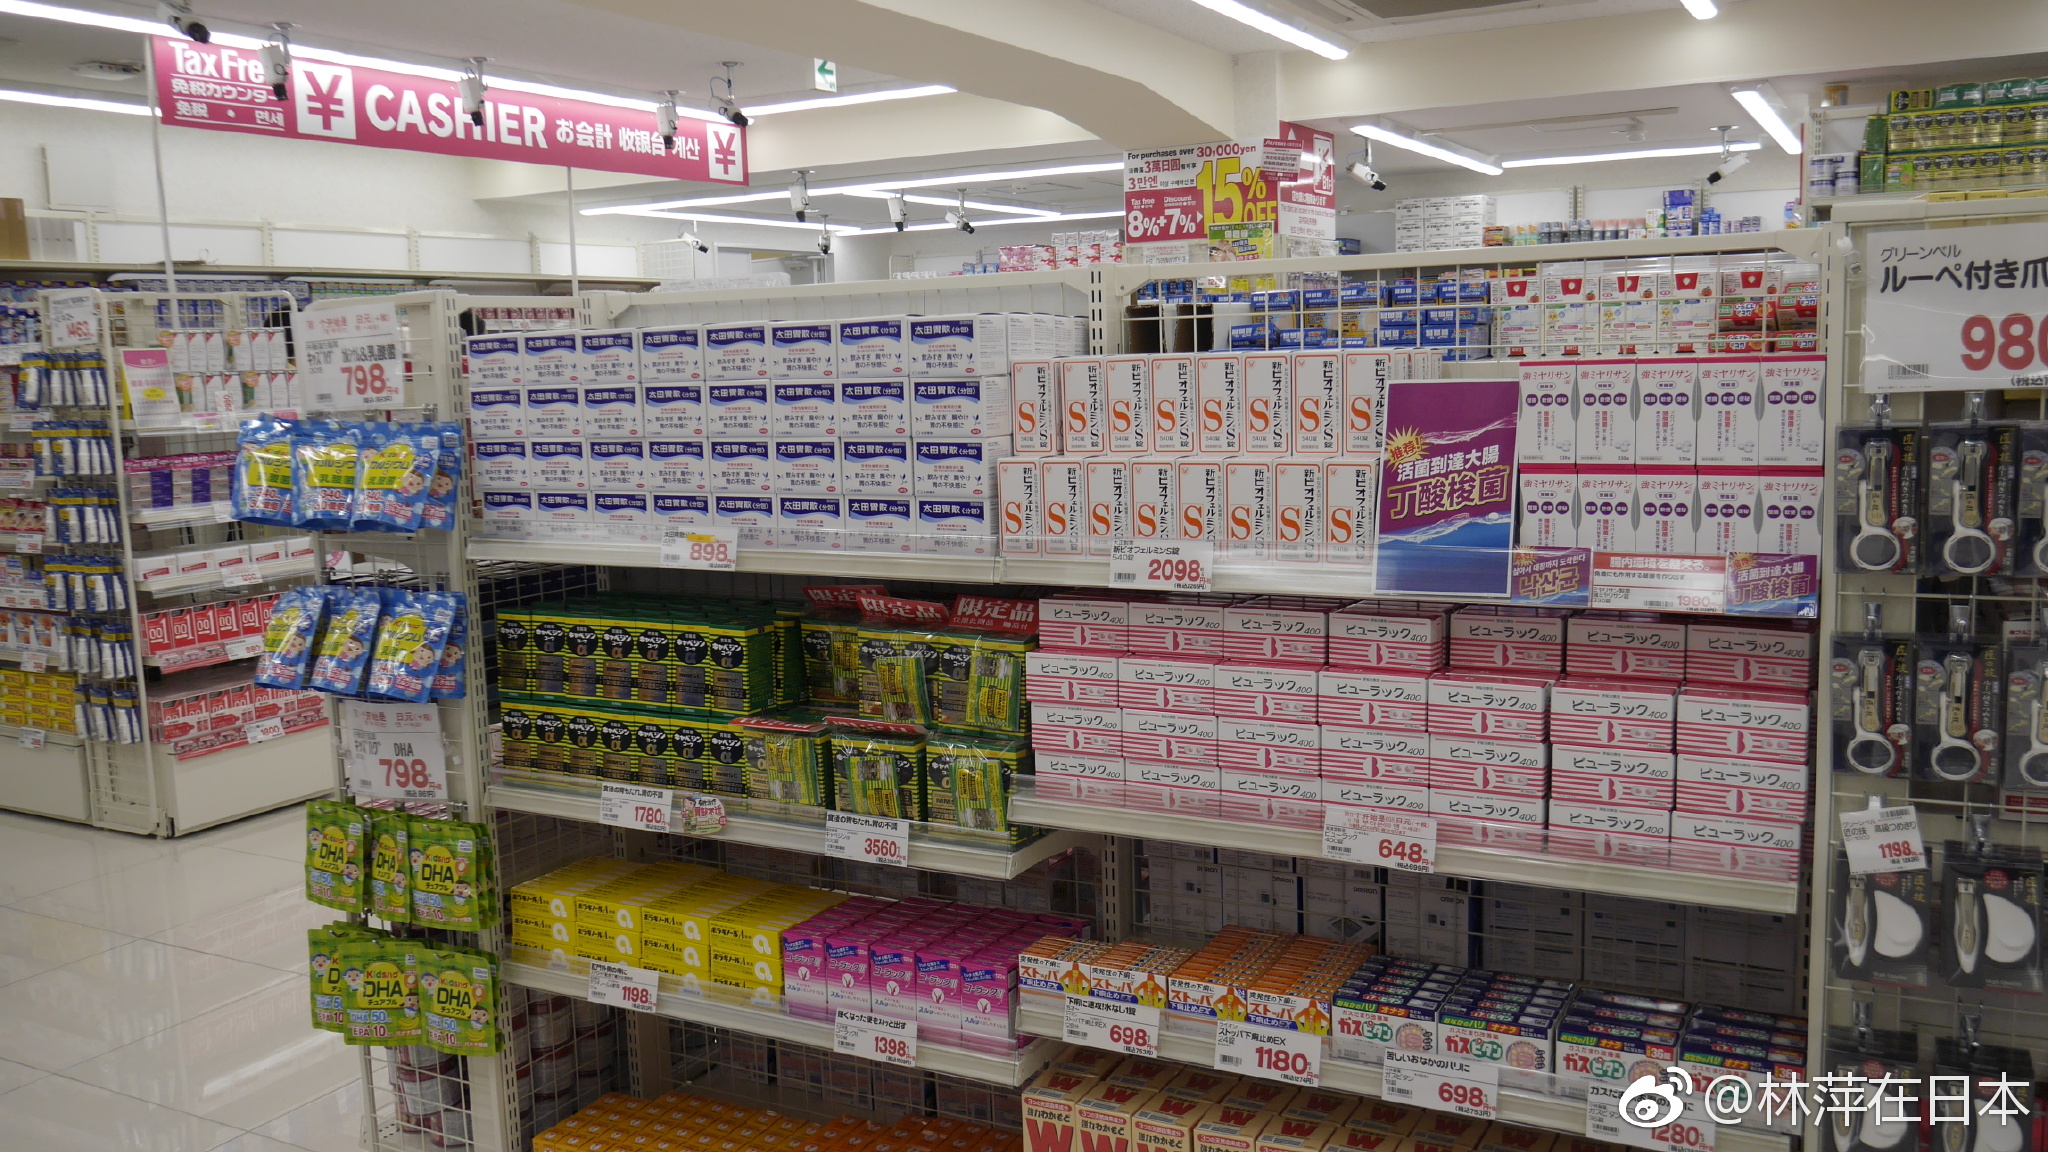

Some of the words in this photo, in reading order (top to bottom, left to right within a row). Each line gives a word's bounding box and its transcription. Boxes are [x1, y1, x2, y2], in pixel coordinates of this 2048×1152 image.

[169, 41, 218, 78] Tax
[222, 48, 265, 84] Fre
[172, 79, 277, 102] 免税カウンター
[175, 100, 209, 118] 免税
[255, 109, 285, 127] 면세
[364, 84, 548, 149] CASHIER
[555, 118, 613, 150] お会計
[671, 137, 701, 161] 계산
[1128, 152, 1139, 160] For
[1141, 150, 1177, 161] purchases
[1179, 147, 1195, 156] over
[1164, 195, 1192, 203] Discount
[1244, 200, 1277, 221] OFF
[1880, 245, 1962, 263] グリーンベル
[340, 363, 386, 395] 798
[1018, 402, 1036, 433] S
[1112, 400, 1131, 432] S
[1204, 399, 1223, 432] S
[1300, 398, 1320, 432] S
[1397, 445, 1499, 482] 活菌到達大腸
[1387, 465, 1510, 519] 丁酸梭菌
[1005, 502, 1022, 534] S
[1231, 505, 1250, 540] S
[1331, 508, 1352, 542] S
[690, 543, 728, 562] 898
[1113, 545, 1180, 556] 新ビオフェルミンS錠
[1148, 558, 1200, 582] 2098
[1519, 566, 1580, 600] 낙산균
[861, 597, 942, 619] 限定品
[957, 597, 1035, 622] 限定品
[1677, 595, 1711, 607] 1980
[393, 742, 414, 757] DHA
[378, 758, 429, 789] 798
[634, 806, 662, 824] 1780
[319, 843, 344, 864] DHA
[864, 838, 897, 857] 3560
[1378, 839, 1423, 863] 648
[1878, 840, 1912, 859] 1198
[421, 864, 455, 883] DHA
[1021, 965, 1060, 981] ストッパ
[363, 980, 403, 998] DHA
[437, 988, 472, 1008] DHA
[622, 986, 649, 1004] 1198
[1250, 1002, 1295, 1019] ストッパ
[1109, 1024, 1148, 1047] 698
[1337, 1018, 1393, 1042] ガスピタン
[875, 1036, 907, 1057] 1398
[1445, 1034, 1503, 1060] ガスピタン
[1255, 1046, 1308, 1075] 1180
[1563, 1053, 1626, 1080] ガスピタン
[1101, 1086, 1138, 1103] W
[1438, 1082, 1484, 1108] 698
